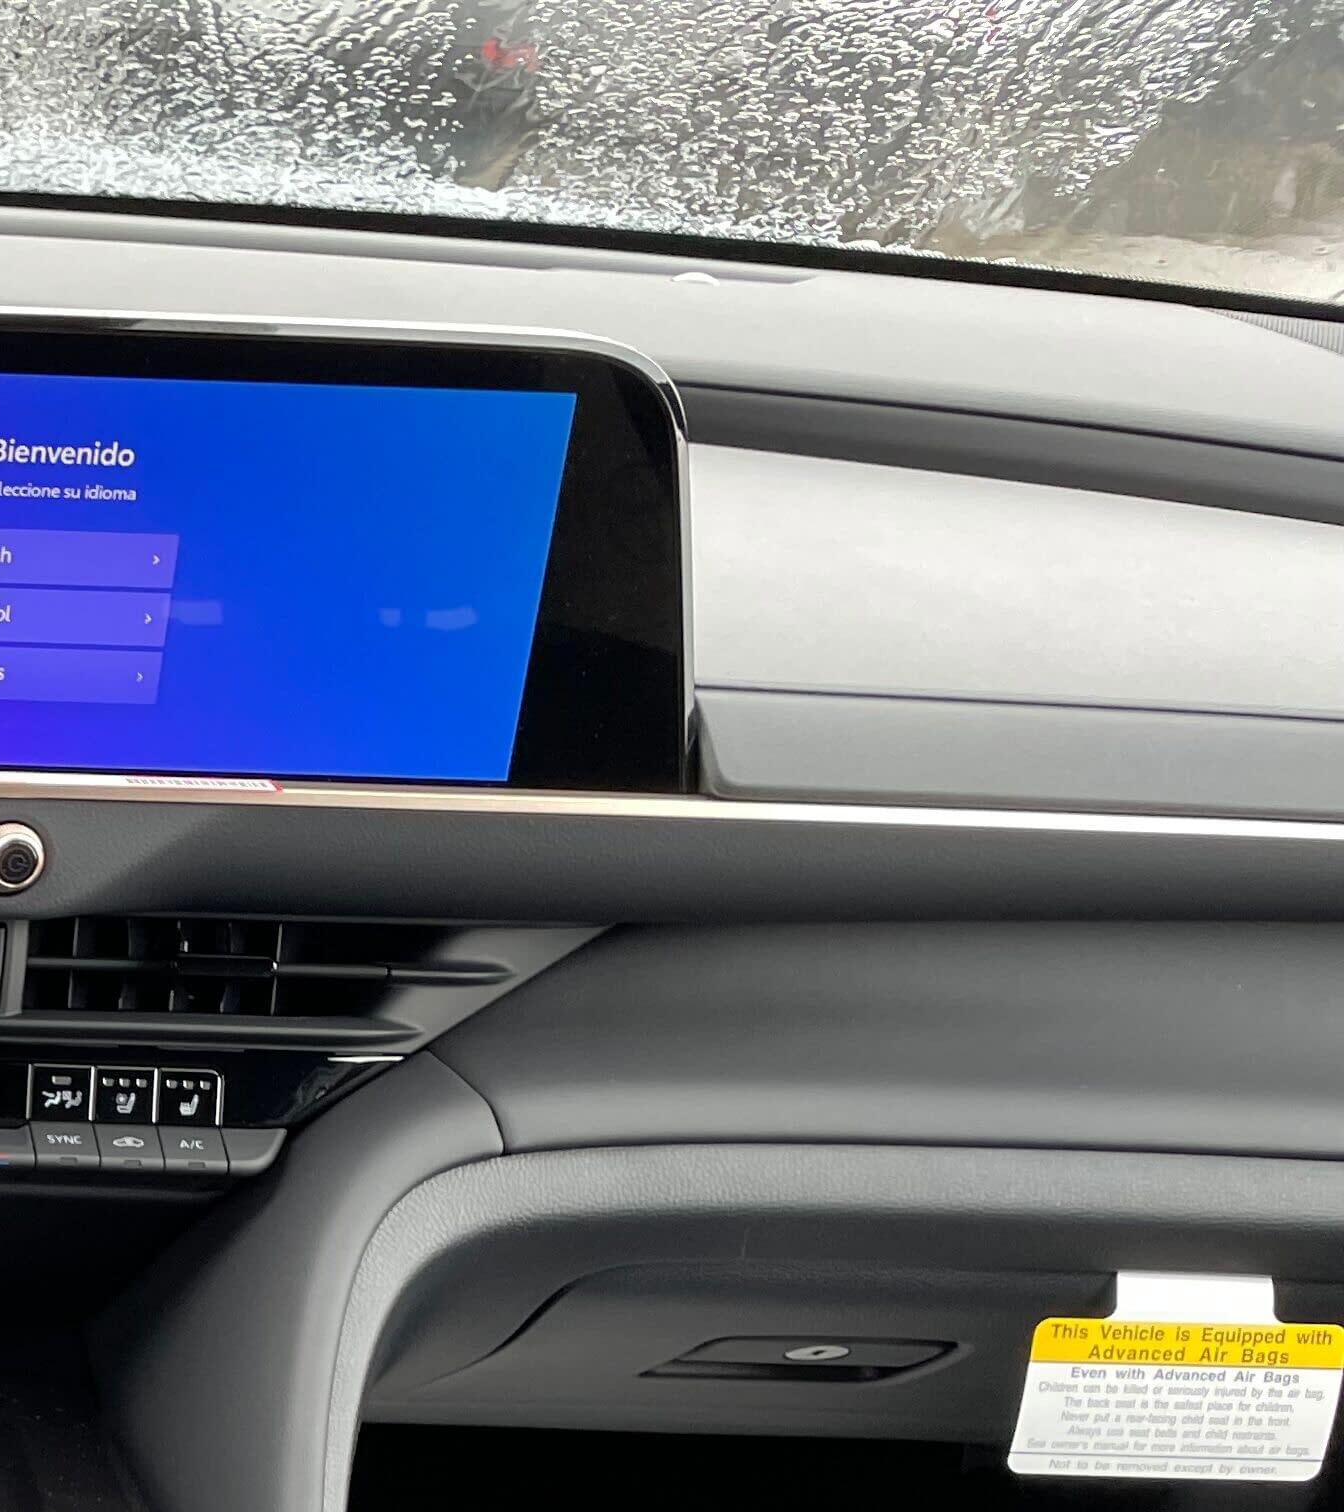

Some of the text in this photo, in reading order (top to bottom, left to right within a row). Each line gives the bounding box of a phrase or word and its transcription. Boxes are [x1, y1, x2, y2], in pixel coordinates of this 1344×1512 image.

[64, 487, 80, 499] su
[84, 484, 137, 501] idioma
[46, 1134, 83, 1145] SYNC
[179, 1137, 205, 1151] A/C
[1052, 1324, 1332, 1346] This Vehicle is Equipped with
[1088, 1345, 1290, 1365] Advanced Air Bags
[1071, 1367, 1300, 1386] Even with Advanced Air Bags
